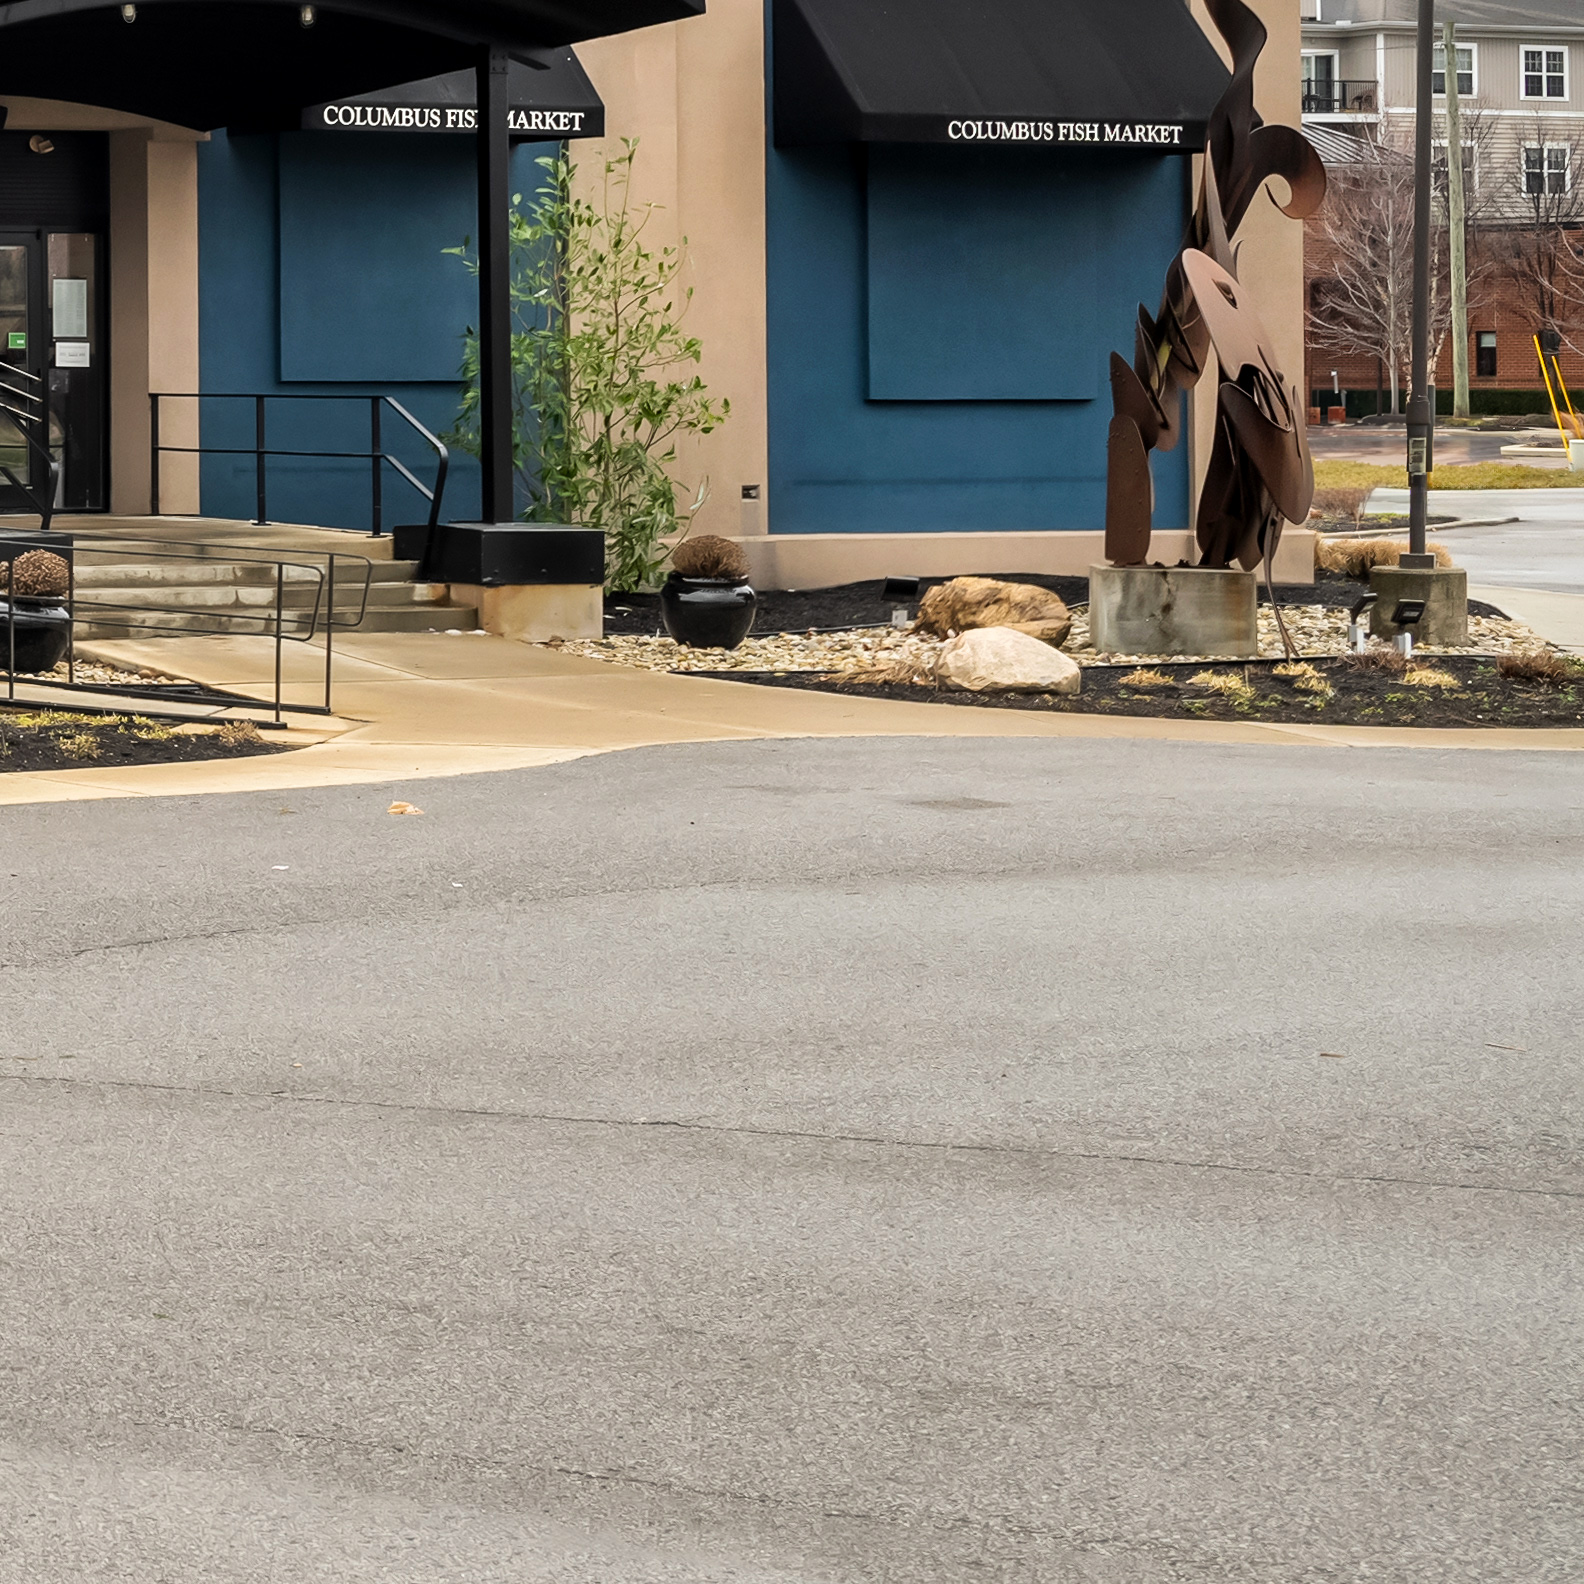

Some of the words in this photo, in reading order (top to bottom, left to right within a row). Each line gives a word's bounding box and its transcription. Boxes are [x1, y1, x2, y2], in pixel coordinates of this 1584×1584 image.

[323, 106, 440, 127] COLUMBUS
[446, 109, 478, 128] FIS
[948, 120, 1053, 140] COLUMBUS
[1058, 122, 1099, 141] FISH
[1104, 124, 1183, 143] MARKET
